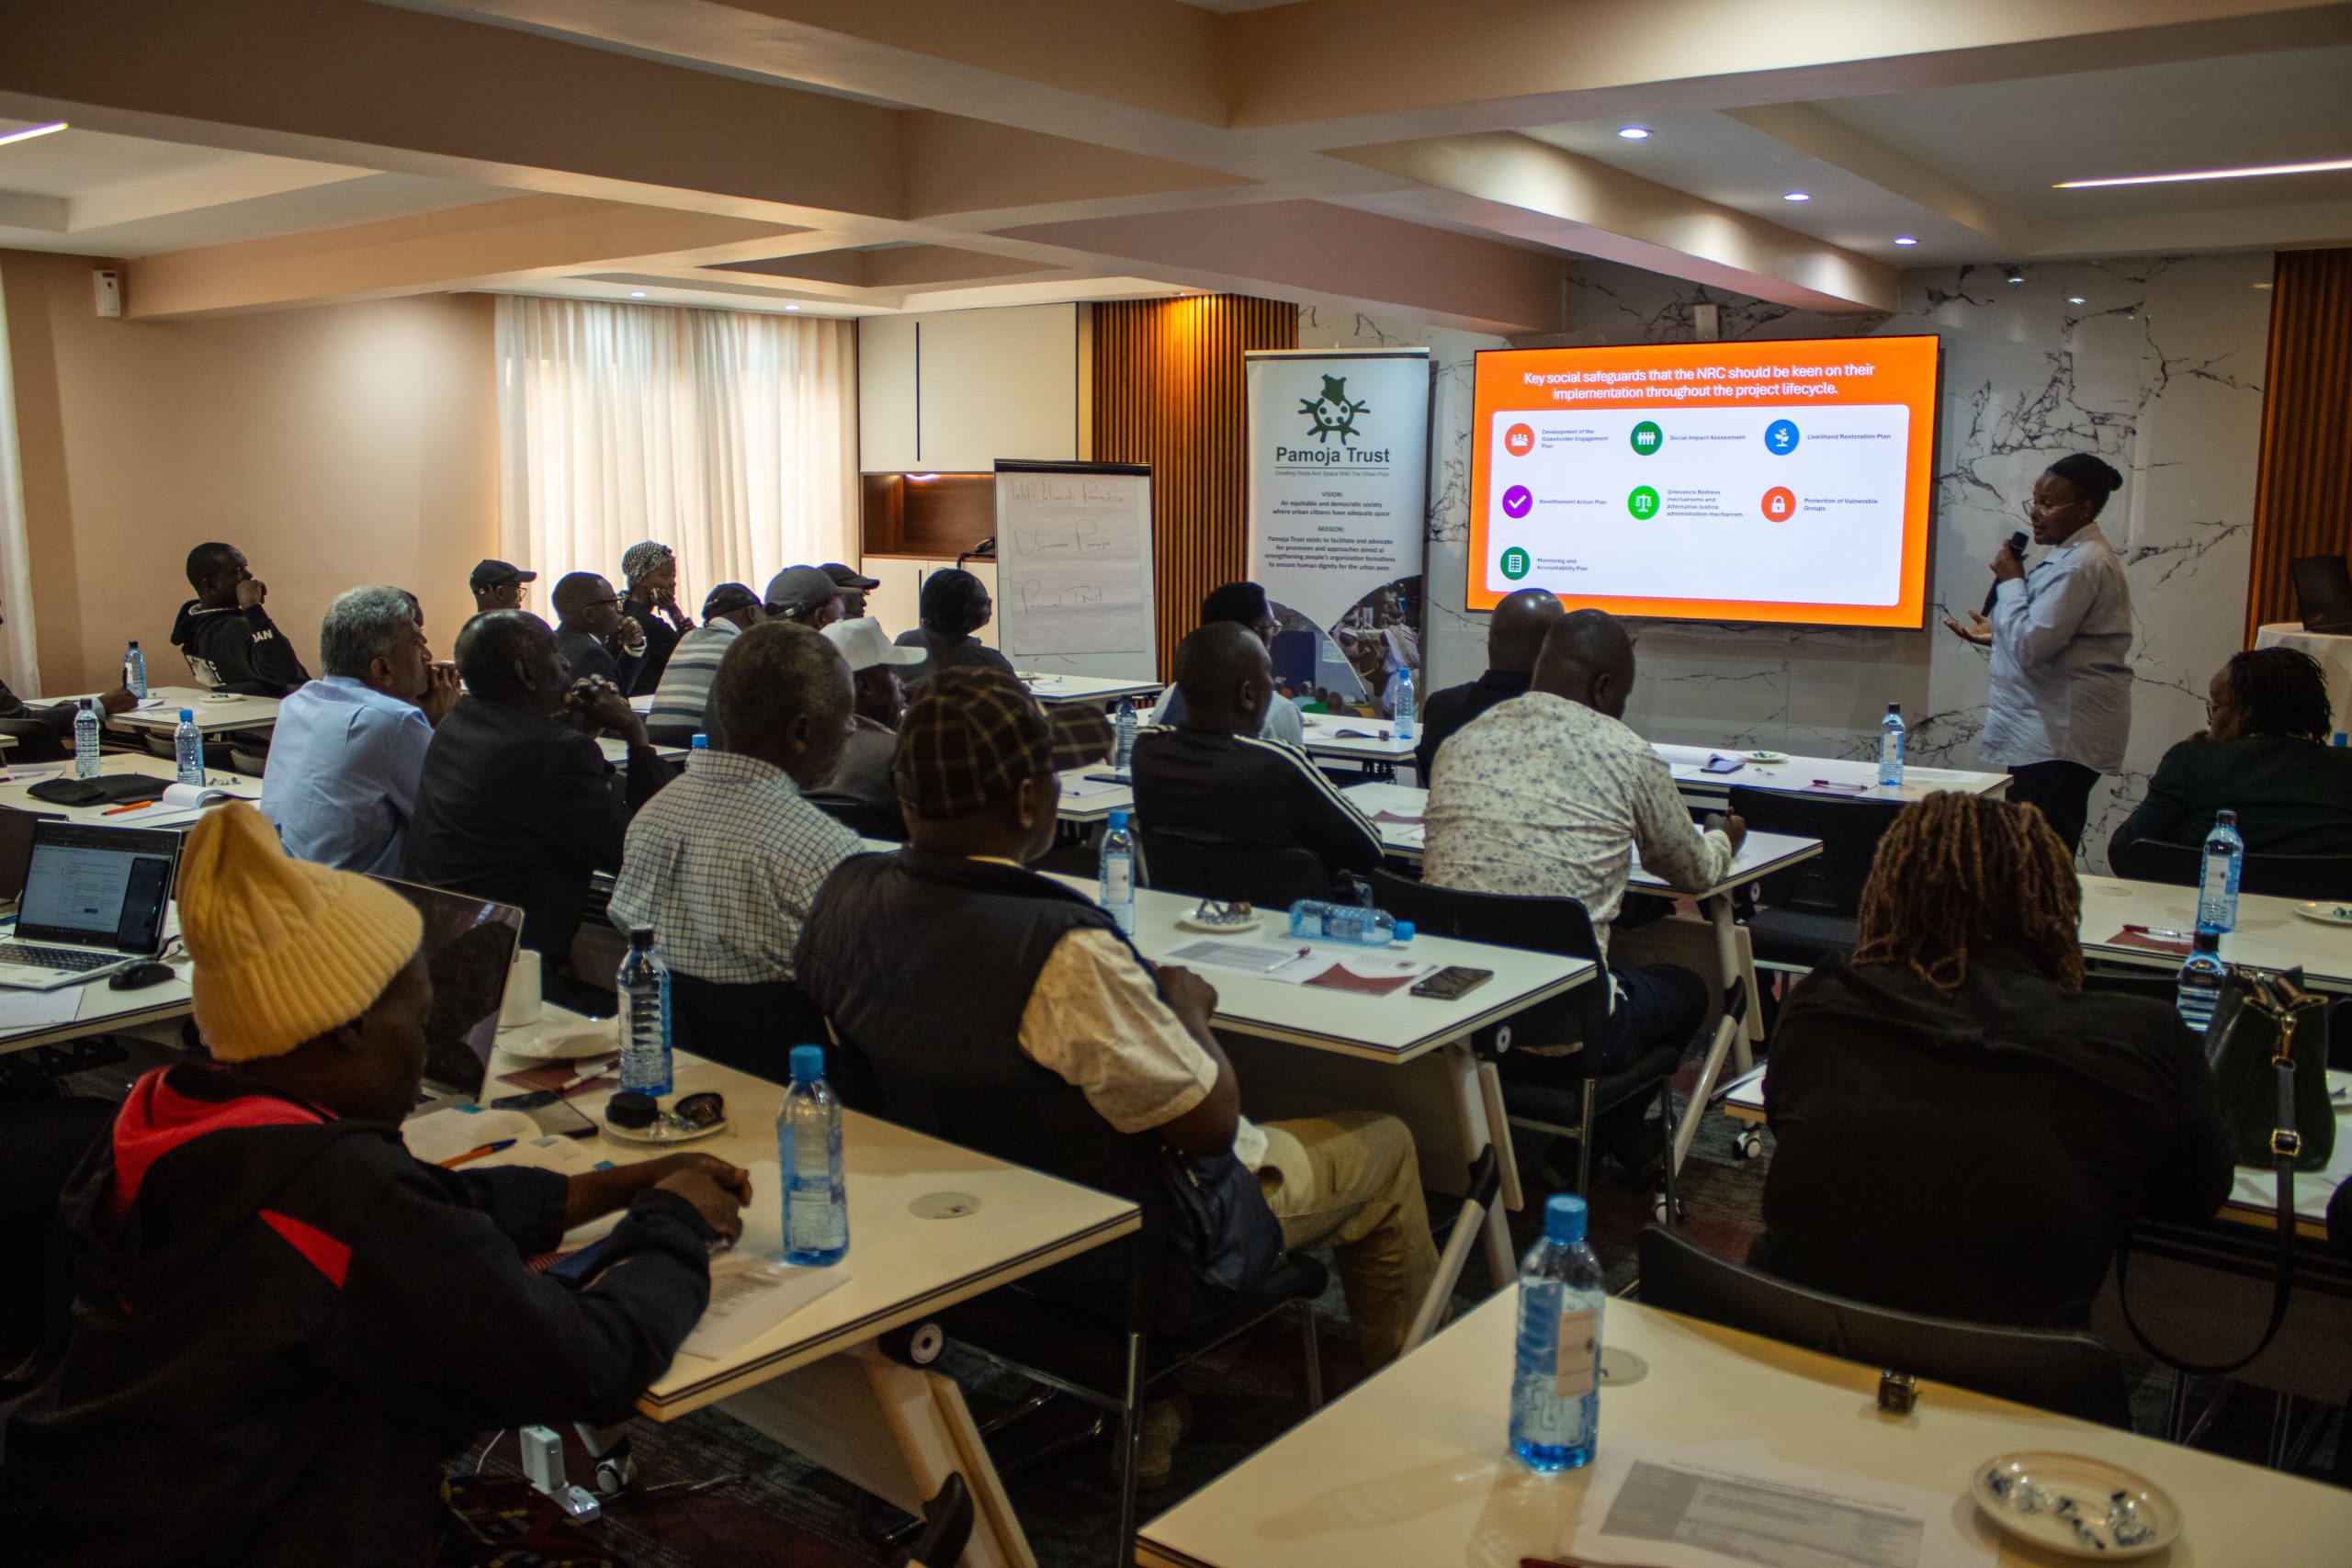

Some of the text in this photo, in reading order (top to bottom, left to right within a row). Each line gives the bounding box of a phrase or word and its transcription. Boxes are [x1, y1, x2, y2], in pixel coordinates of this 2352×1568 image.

[1524, 363, 1874, 387] Key social safeguards that the NRC should be keen on their
[1553, 382, 1838, 401] implementation throughout the project lifecycle.
[1276, 446, 1390, 467] Pamoja Trust
